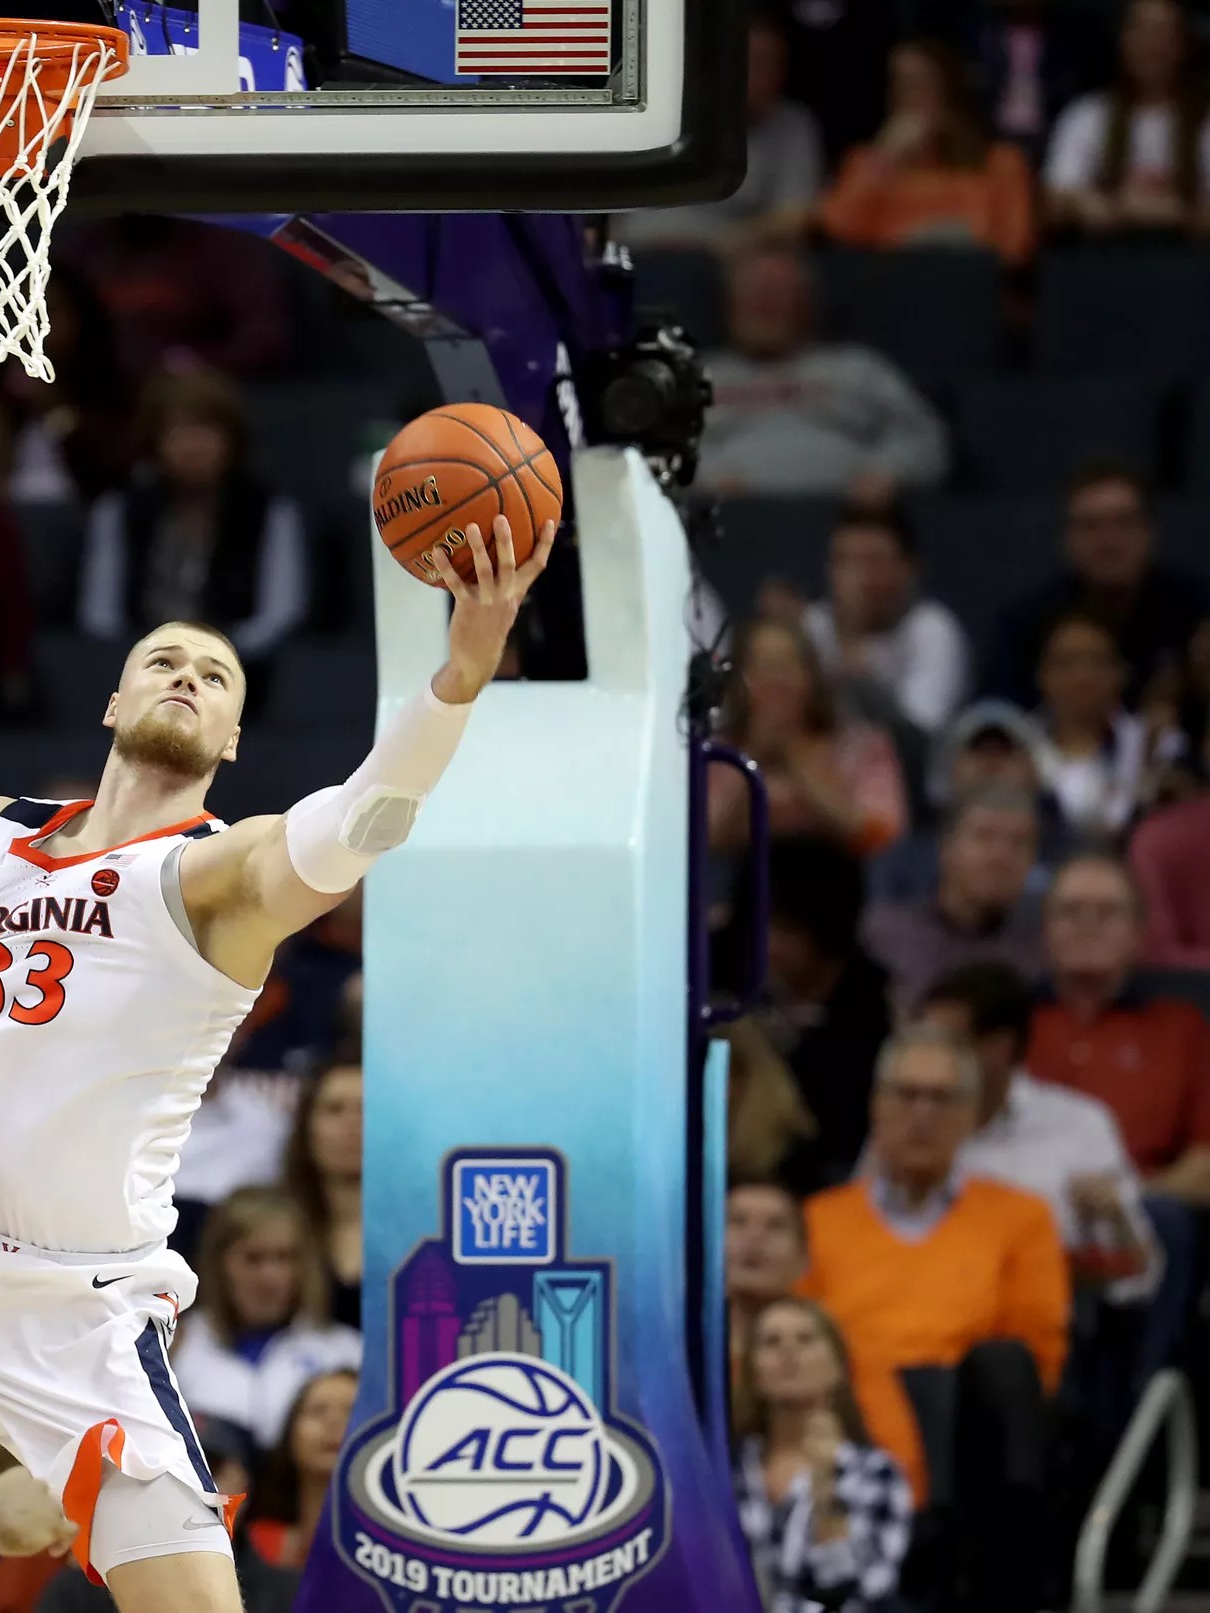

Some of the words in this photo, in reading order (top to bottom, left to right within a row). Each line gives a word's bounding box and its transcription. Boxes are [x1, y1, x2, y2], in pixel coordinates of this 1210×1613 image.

[474, 1174, 539, 1201] NEW
[463, 1197, 546, 1225] YORK
[474, 1222, 537, 1249] LIFE
[425, 1428, 592, 1471] ACC
[355, 1532, 428, 1592] 2019
[432, 1529, 653, 1604] TOURNAMENT
